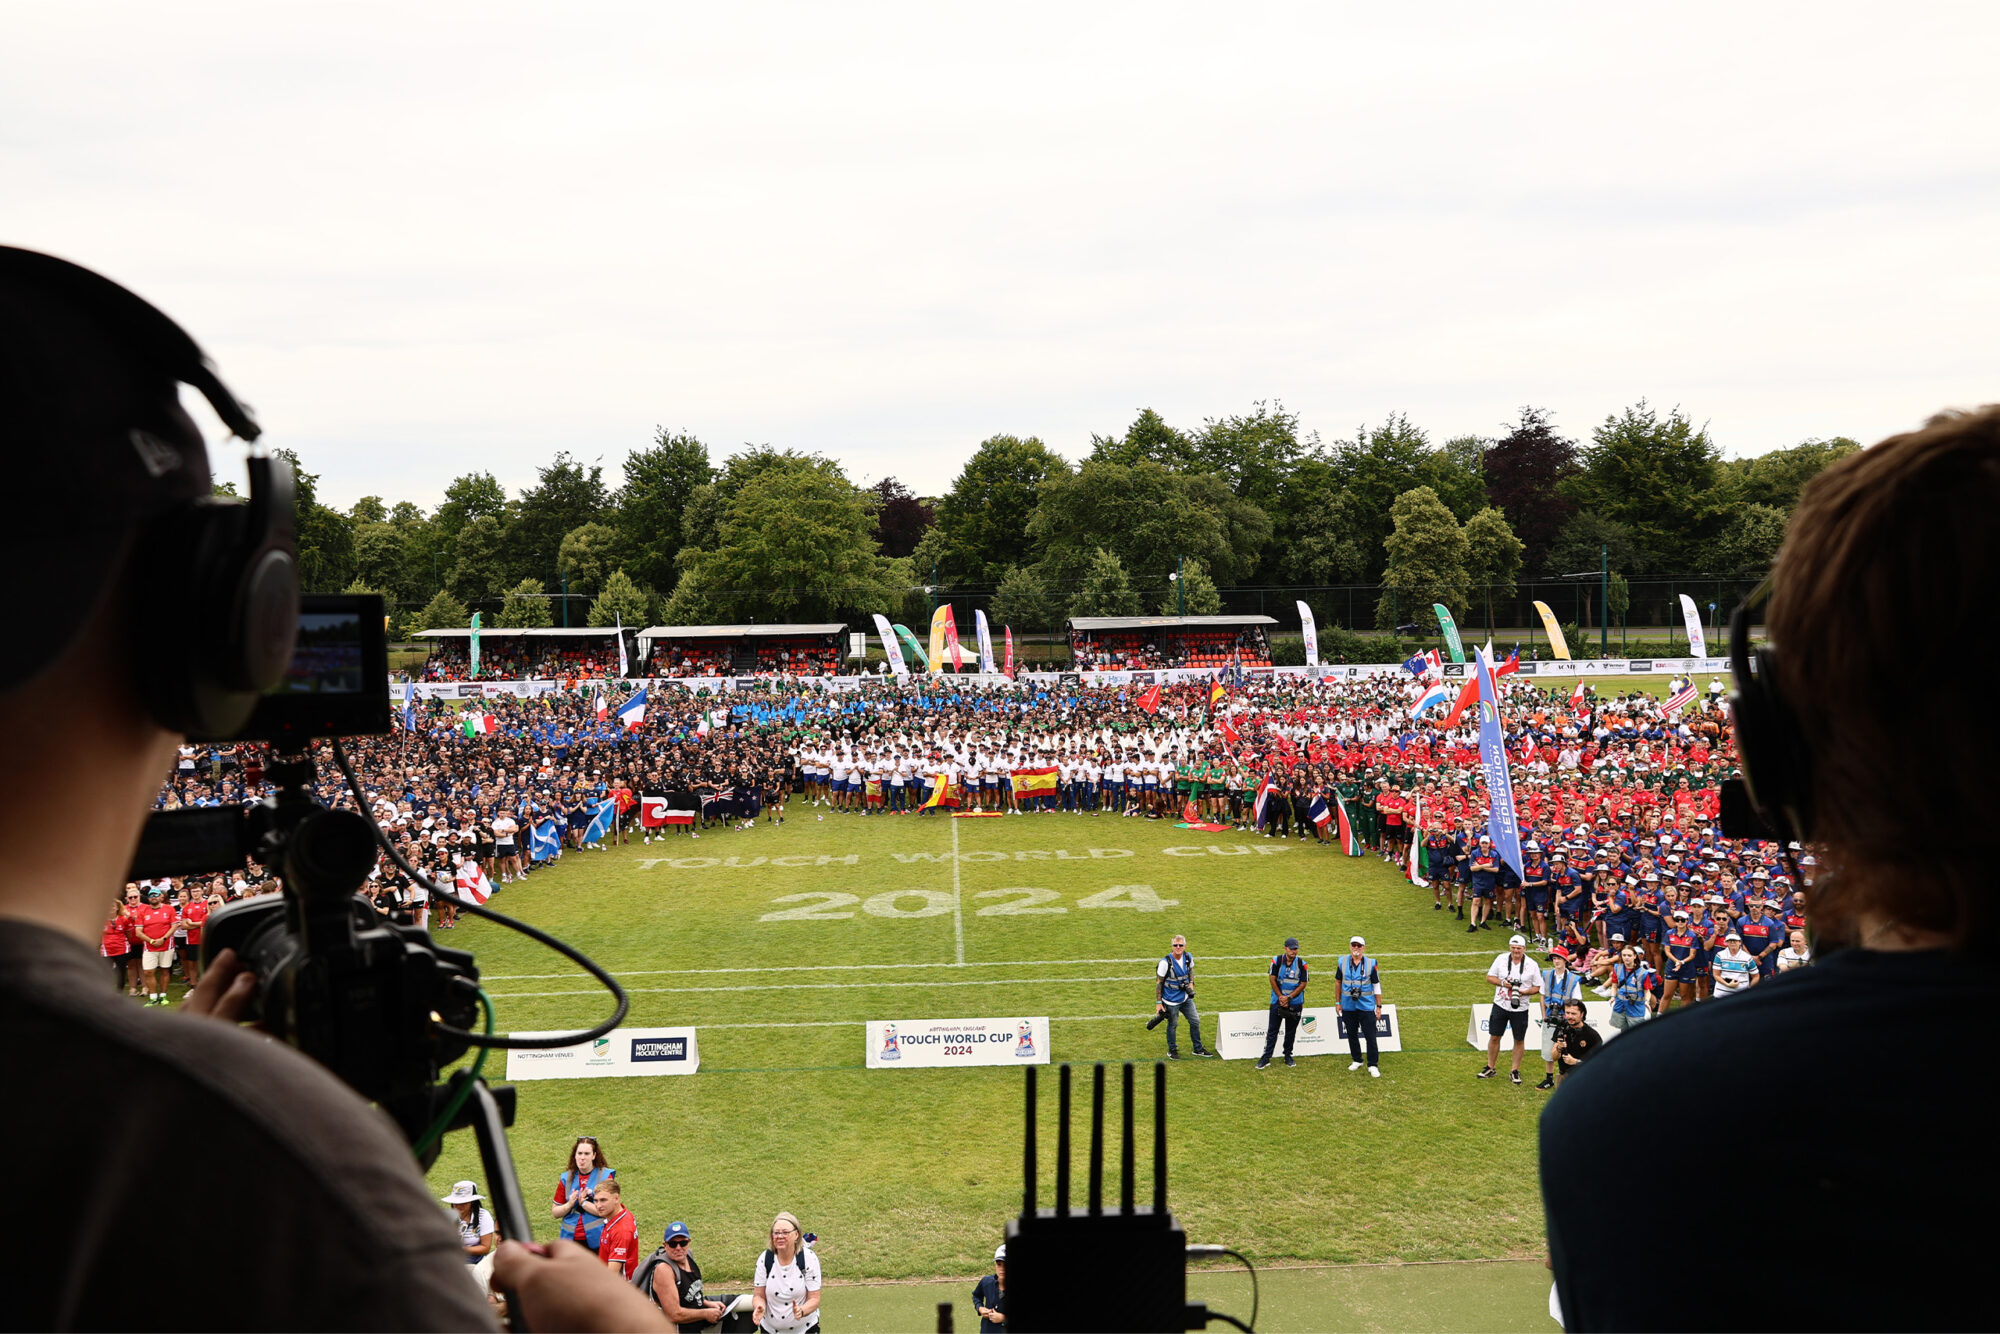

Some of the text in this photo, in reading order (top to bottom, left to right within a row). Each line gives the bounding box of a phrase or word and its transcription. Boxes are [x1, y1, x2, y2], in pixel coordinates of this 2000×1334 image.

[632, 844, 1291, 870] TOUCH WORLD CUP
[758, 884, 1180, 922] 2024
[899, 1033, 1013, 1045] TOUCH WORLD CUP
[635, 1042, 683, 1051] NOTTINGHAM
[943, 1045, 973, 1056] 2024
